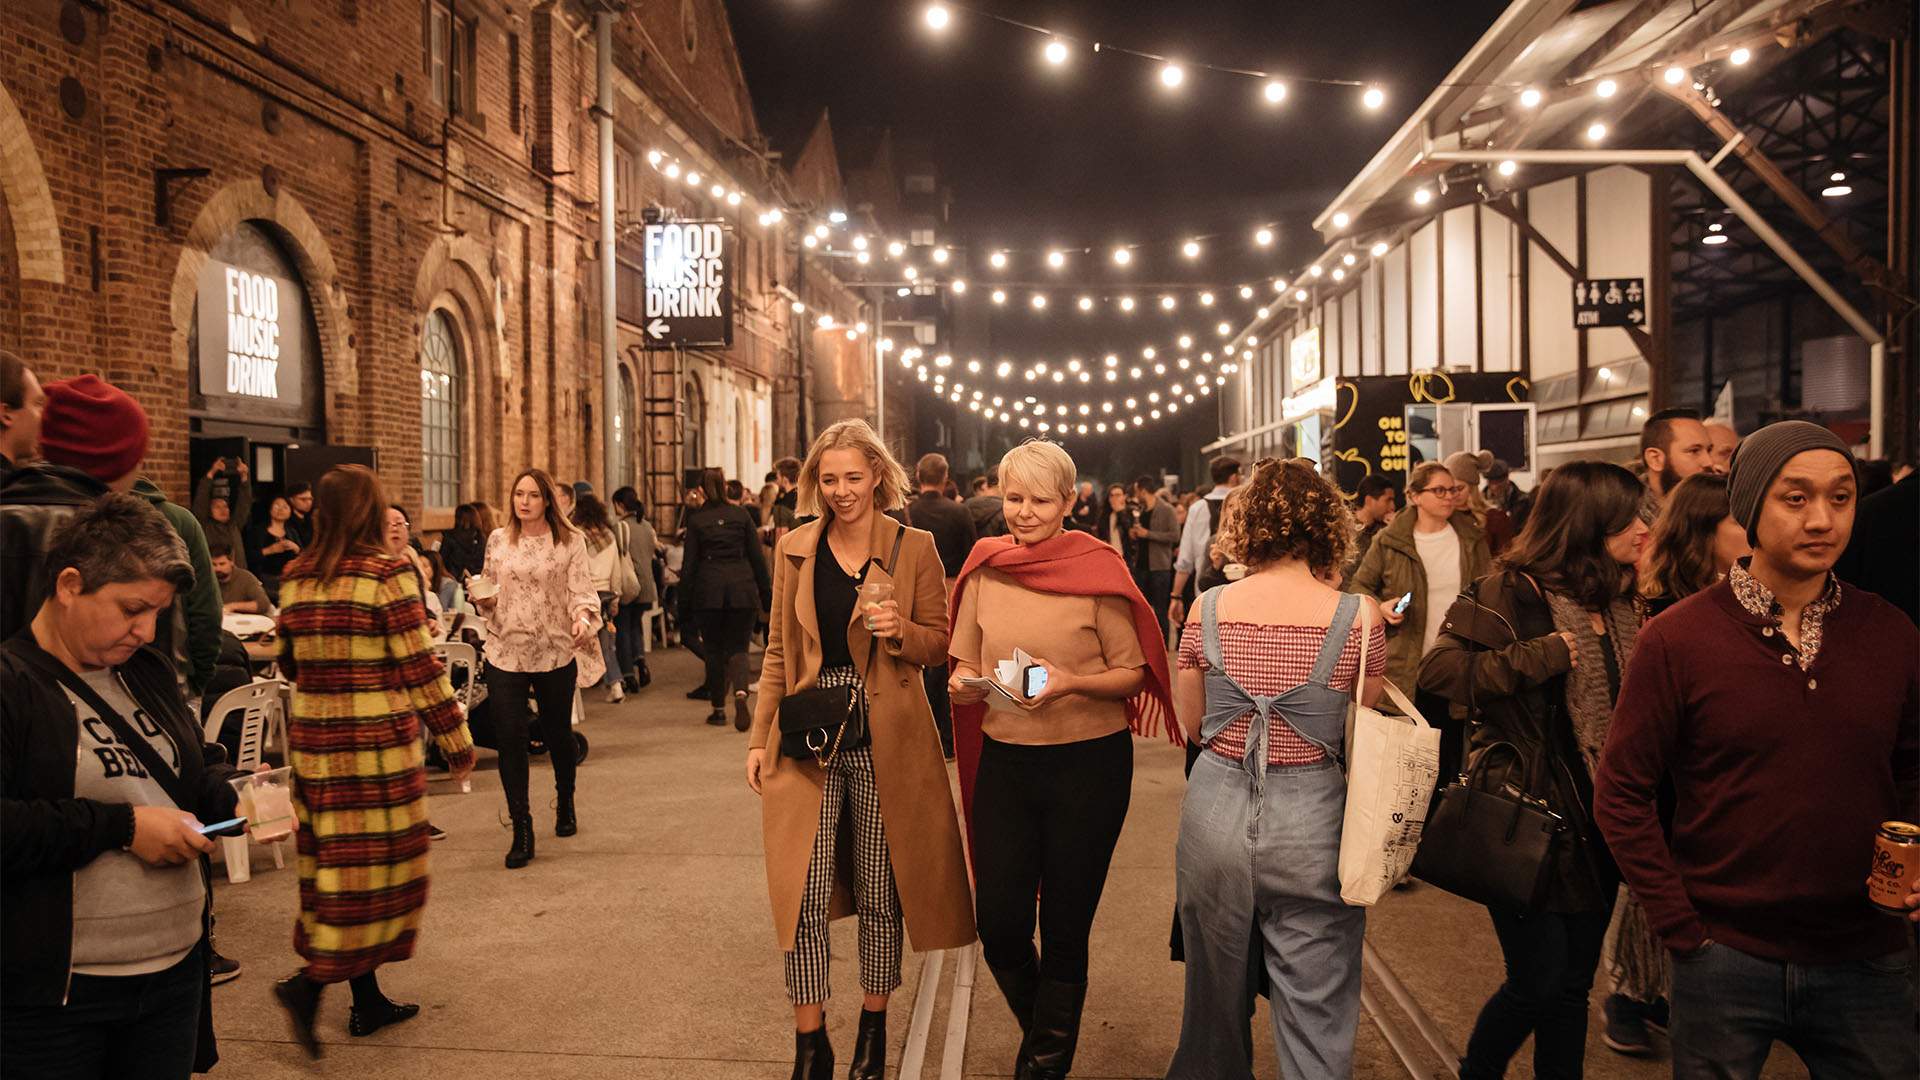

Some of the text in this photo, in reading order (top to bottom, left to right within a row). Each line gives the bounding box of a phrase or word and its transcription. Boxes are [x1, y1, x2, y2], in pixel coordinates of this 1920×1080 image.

[645, 224, 723, 259] FOOD
[645, 258, 724, 289] MUSIC
[226, 266, 279, 322] FOOD
[645, 287, 723, 318] DRINK
[227, 312, 280, 360] MUSIC
[1577, 311, 1600, 326] ATM
[226, 352, 279, 399] DRINK
